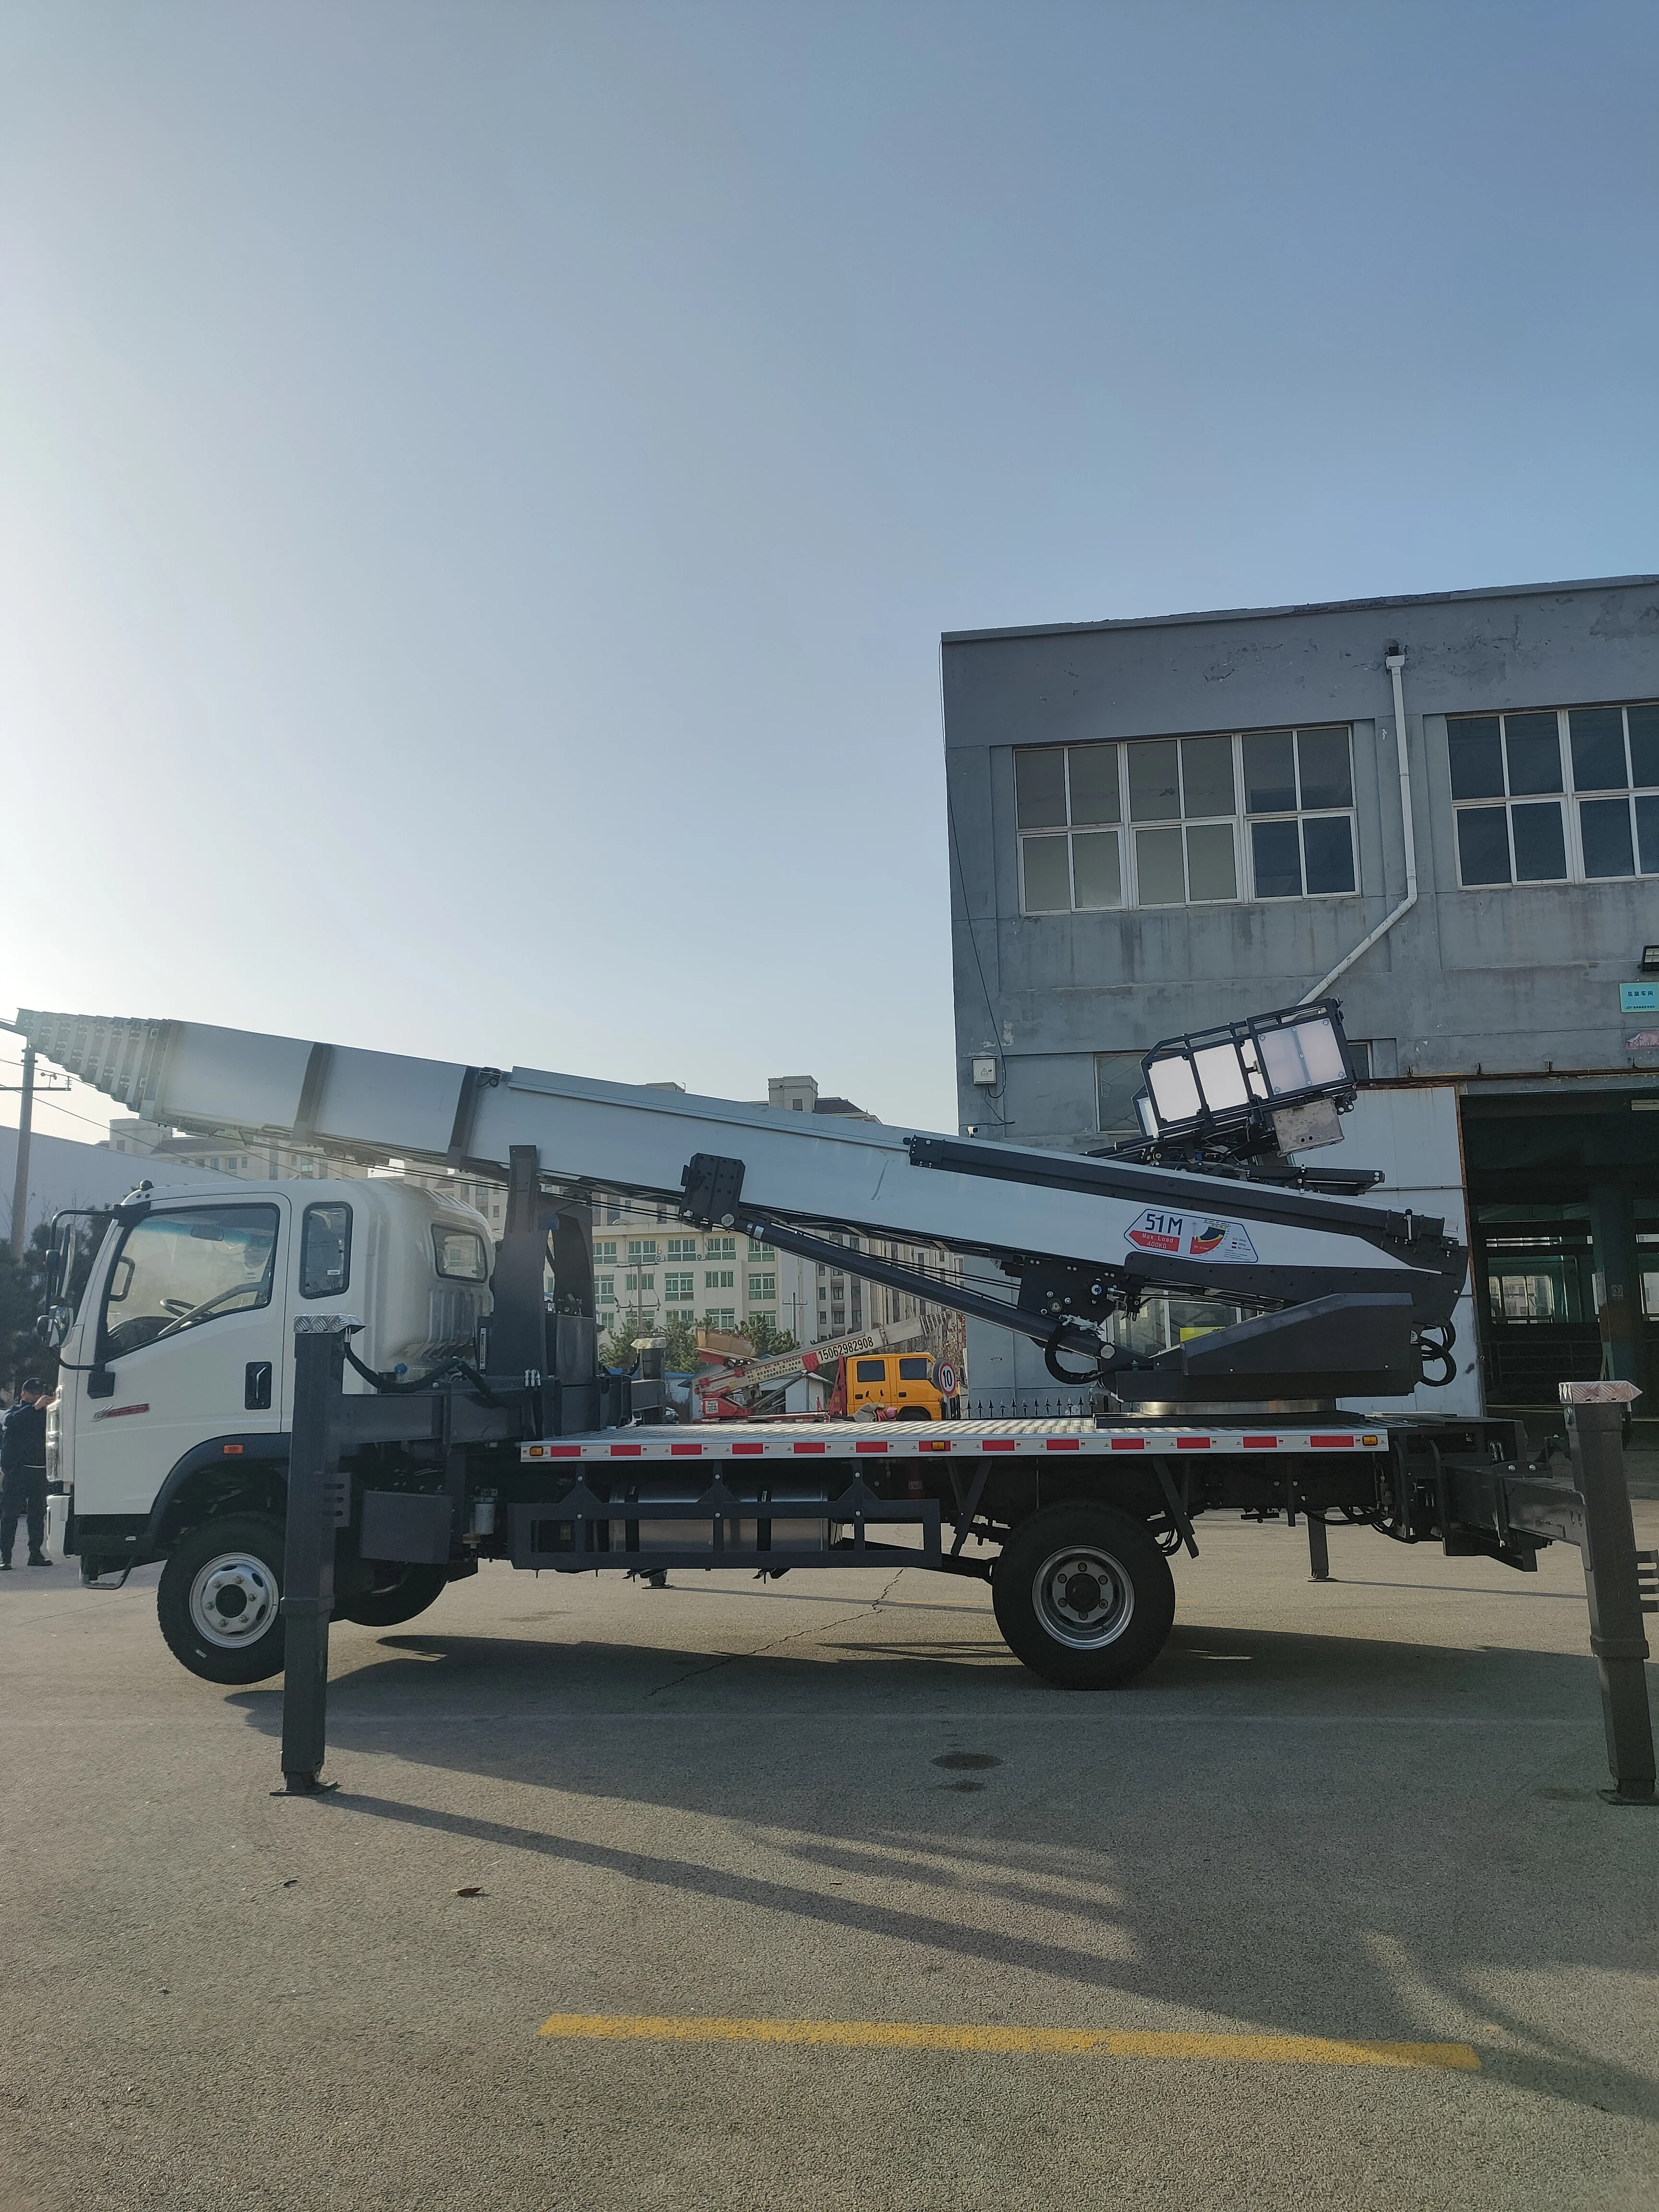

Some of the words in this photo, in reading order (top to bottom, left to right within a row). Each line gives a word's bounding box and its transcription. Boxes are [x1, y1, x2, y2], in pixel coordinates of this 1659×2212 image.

[1145, 1213, 1183, 1236] 51M
[1147, 1240, 1167, 1249] 400KG
[1157, 1235, 1174, 1243] Load
[818, 1336, 874, 1361] 15062982908
[943, 1369, 952, 1387] 10
